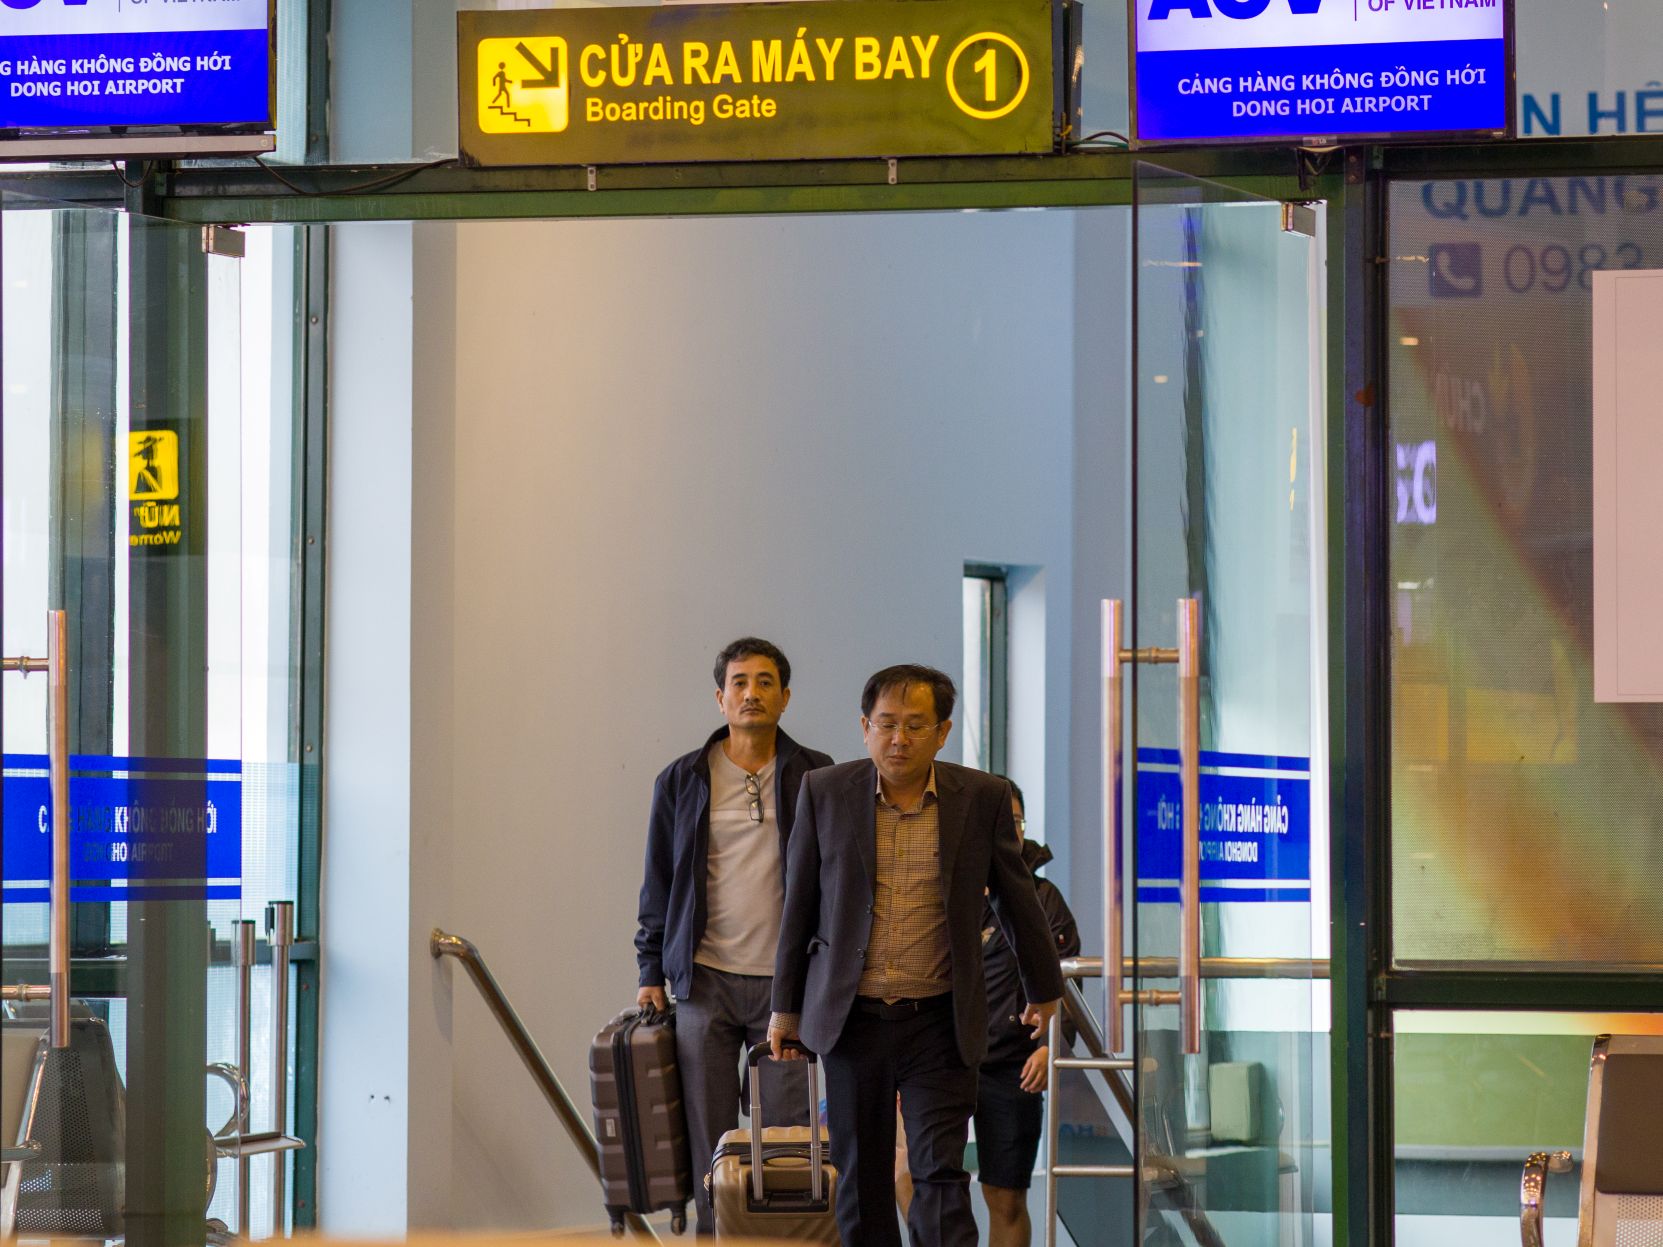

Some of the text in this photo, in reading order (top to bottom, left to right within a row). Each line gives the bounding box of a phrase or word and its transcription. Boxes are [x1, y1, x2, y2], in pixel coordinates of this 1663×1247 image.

[17, 56, 66, 75] HÀNG
[71, 54, 134, 74] KHÔNG
[139, 52, 191, 73] ĐỒNG
[196, 51, 231, 71] HỚI
[579, 26, 940, 88] CỬA RA MÁY BAY
[10, 78, 185, 97] DONG HOI AIRPORT
[974, 48, 997, 102] 1
[1177, 63, 1487, 95] CẢNG HÀNG KHÔNG ĐỒNG HỚI
[585, 93, 777, 126] Boarding Gate
[1232, 94, 1433, 117] DONG HOI AIRPORT
